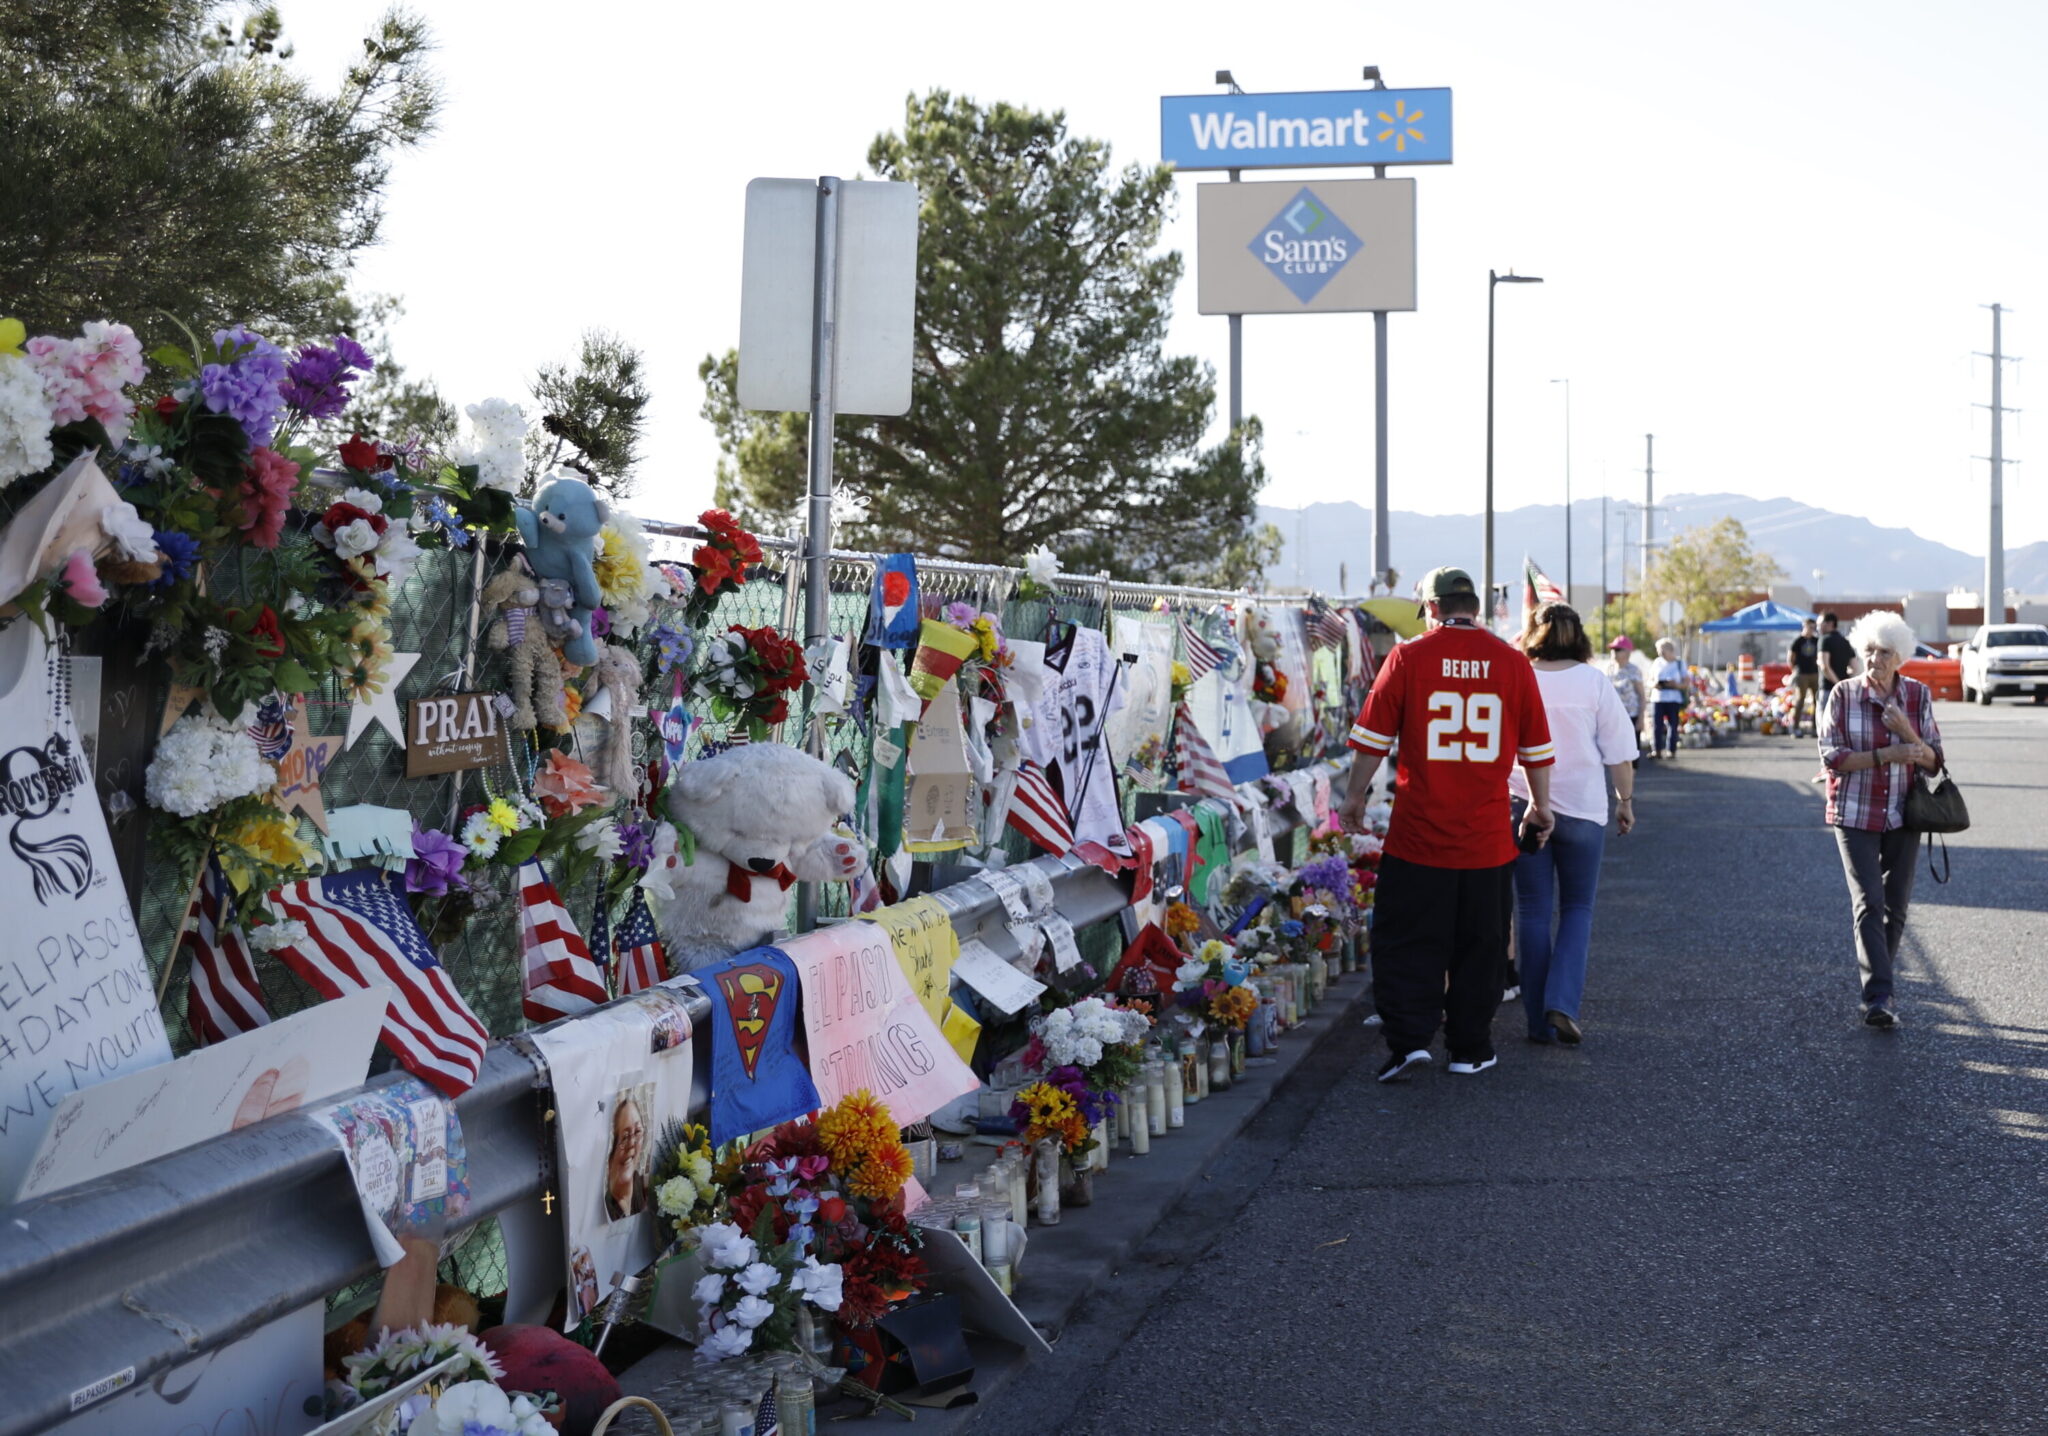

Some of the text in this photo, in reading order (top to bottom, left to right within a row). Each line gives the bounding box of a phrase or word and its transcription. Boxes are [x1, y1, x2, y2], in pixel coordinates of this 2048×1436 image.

[1189, 108, 1369, 150] Walmart
[1264, 230, 1347, 264] Sam's
[1283, 262, 1329, 274] CLUB
[1442, 658, 1490, 679] BERRY
[415, 695, 497, 745] PRAY
[1427, 690, 1502, 763] 29
[808, 962, 832, 1034] EL
[834, 943, 894, 1021] PASO
